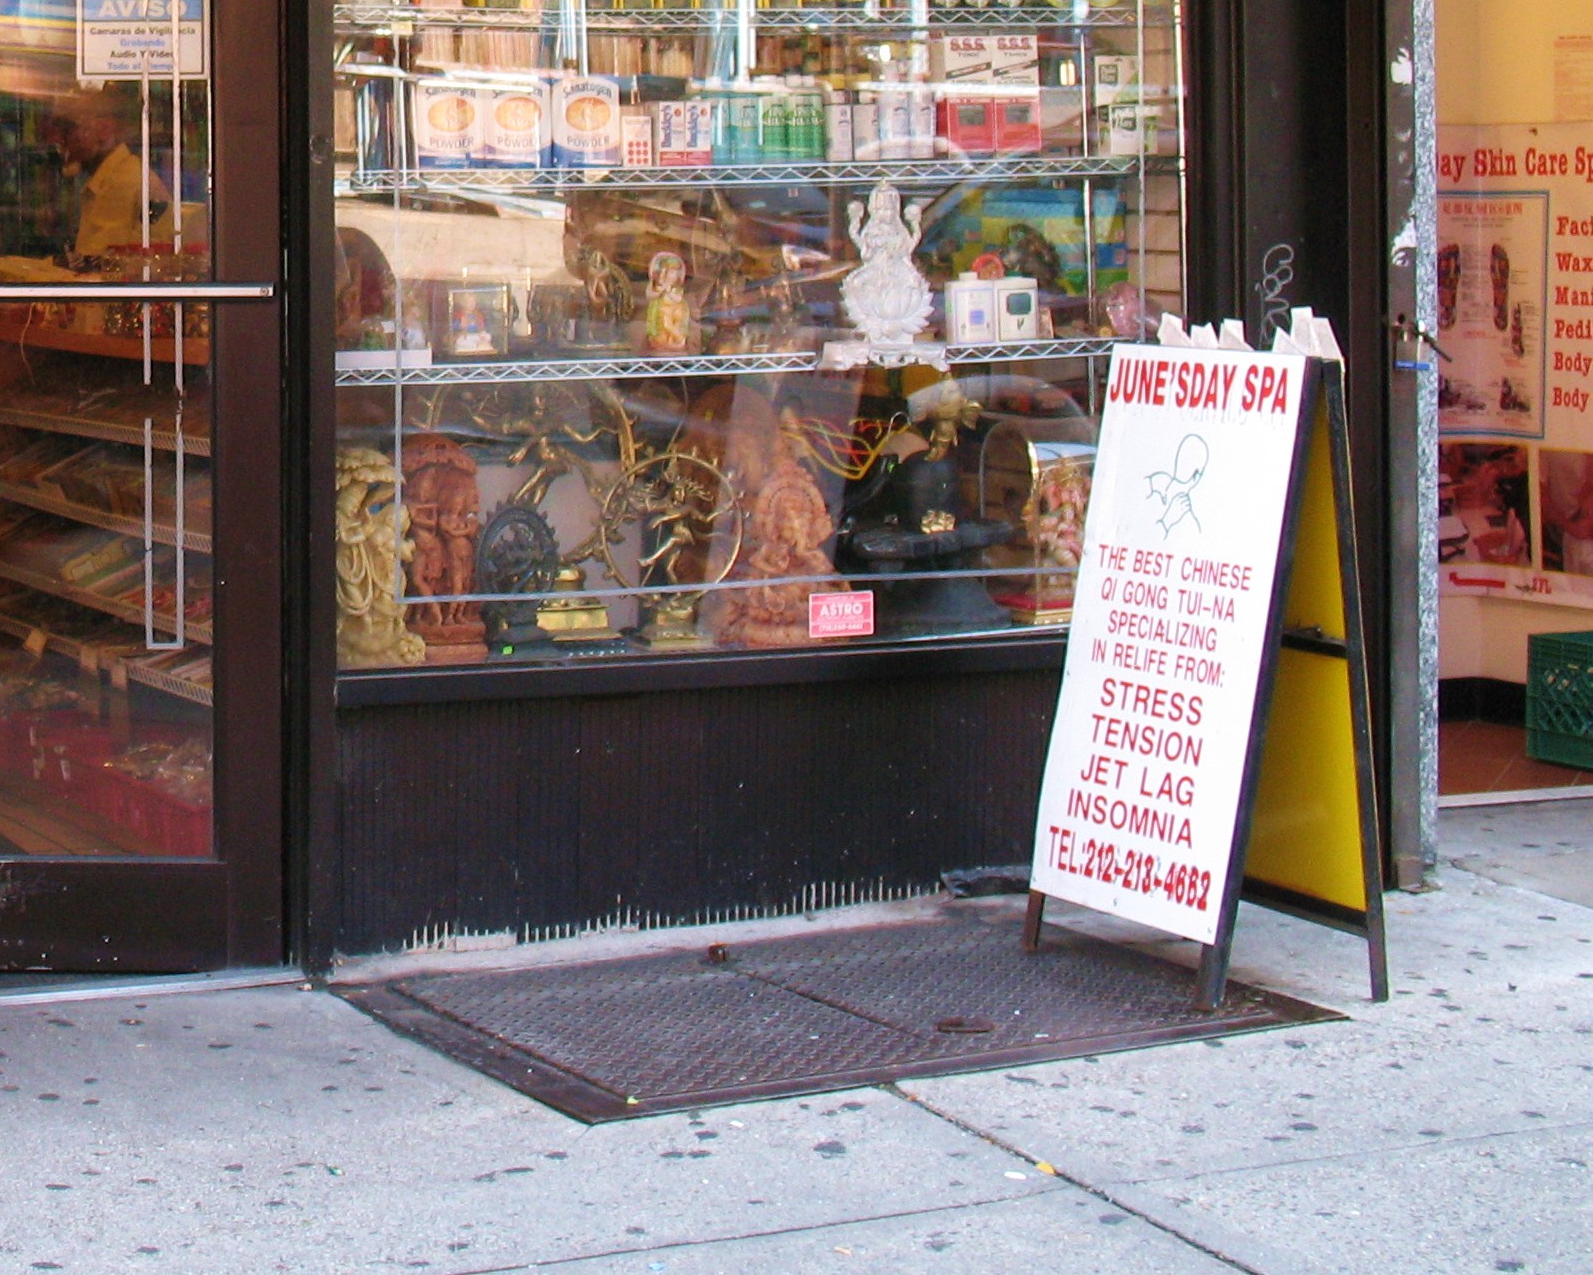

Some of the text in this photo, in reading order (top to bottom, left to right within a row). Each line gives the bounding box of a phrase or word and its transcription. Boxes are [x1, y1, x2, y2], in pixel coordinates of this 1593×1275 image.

[1474, 149, 1516, 176] Skin
[1525, 147, 1568, 175] Care
[1553, 351, 1592, 375] Body
[1242, 363, 1289, 414] SPA
[1552, 386, 1590, 413] Body
[1099, 544, 1253, 592] THE BEST CHINESE
[819, 602, 864, 619] ASTRO
[1101, 577, 1236, 623] QI GONG TUI-NA
[1108, 611, 1217, 653] SPECIALIZING
[1092, 638, 1225, 688] IN RELIFE FROM:
[1100, 678, 1204, 726] STRESS
[1091, 714, 1203, 767] TENSION
[1080, 753, 1195, 807] JET LAG
[1067, 788, 1193, 849] INSOMNIA
